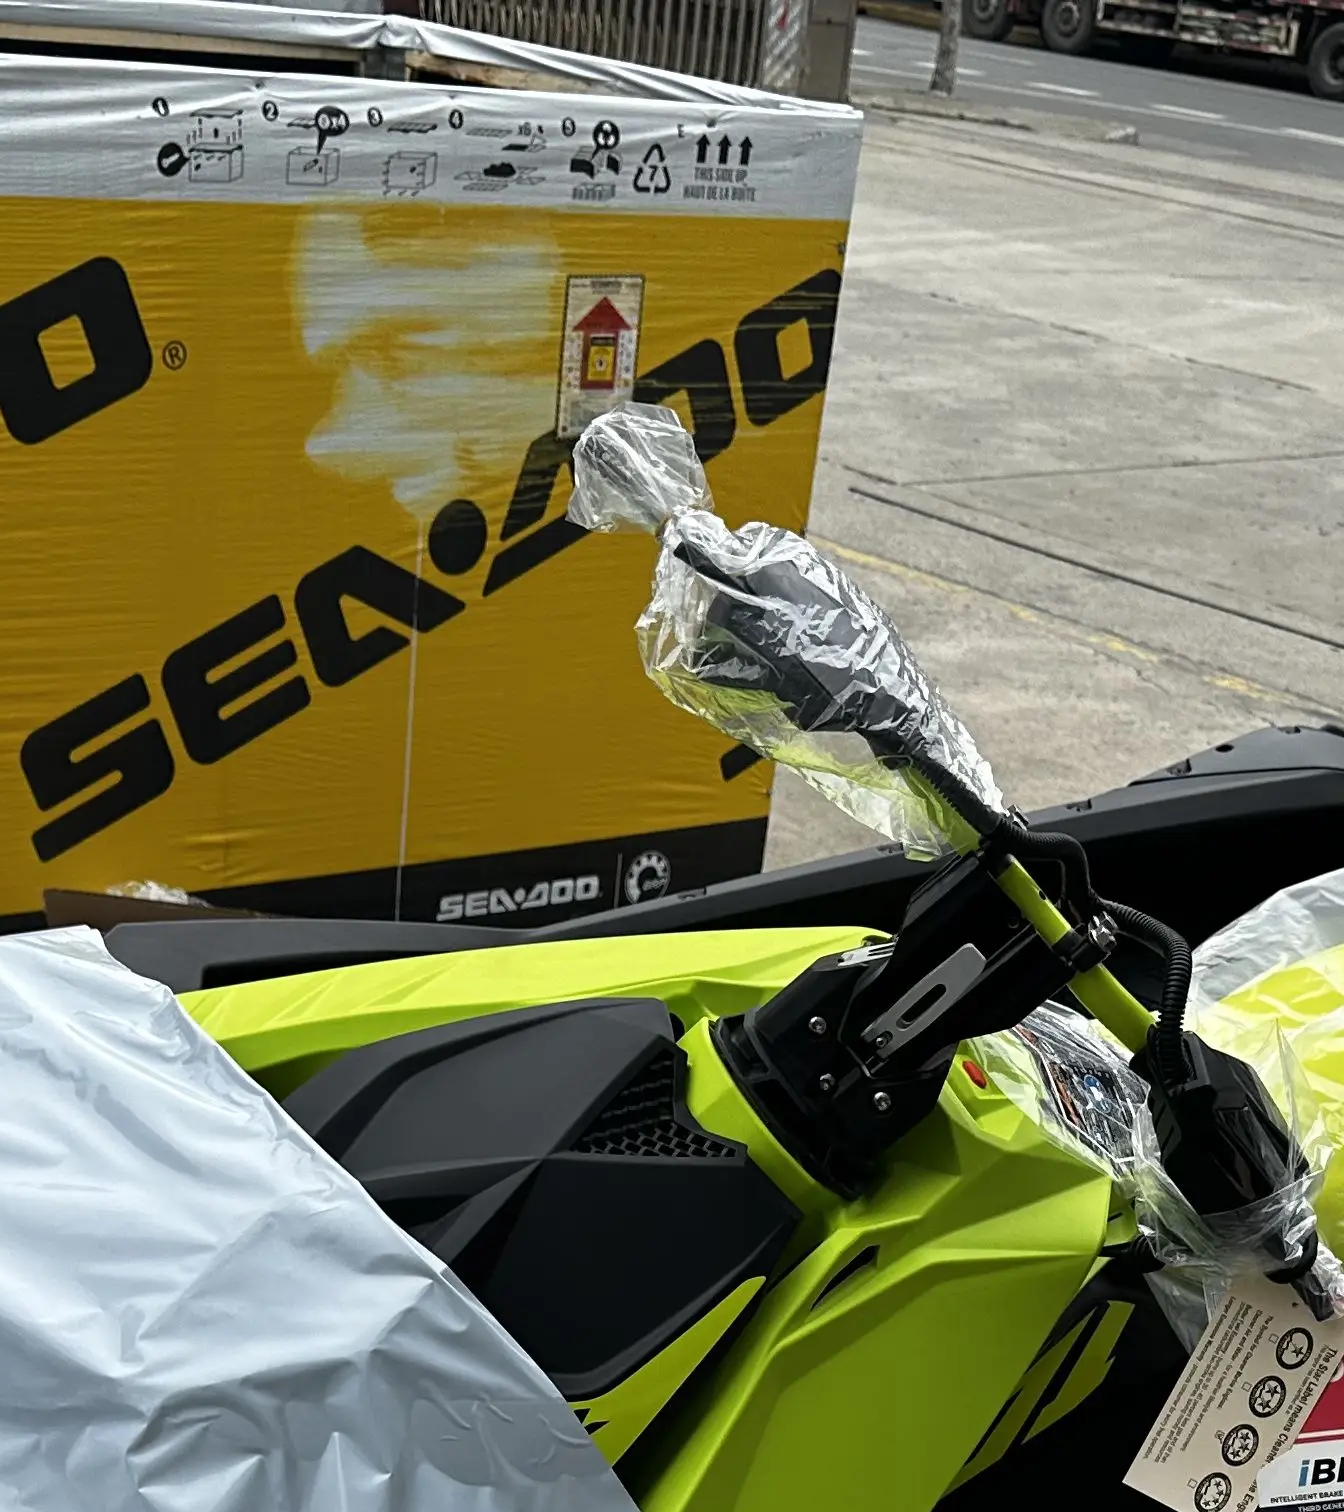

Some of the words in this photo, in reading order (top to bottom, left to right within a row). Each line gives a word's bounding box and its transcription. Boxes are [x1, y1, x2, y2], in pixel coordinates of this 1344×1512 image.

[1311, 1362, 1328, 1383] Star
[1298, 1380, 1318, 1406] Label
[1282, 1403, 1303, 1434] means
[1270, 1492, 1318, 1503] INTELLIGENT
[1318, 1490, 1343, 1498] BRAKE
[1297, 1504, 1321, 1512] THIRD
